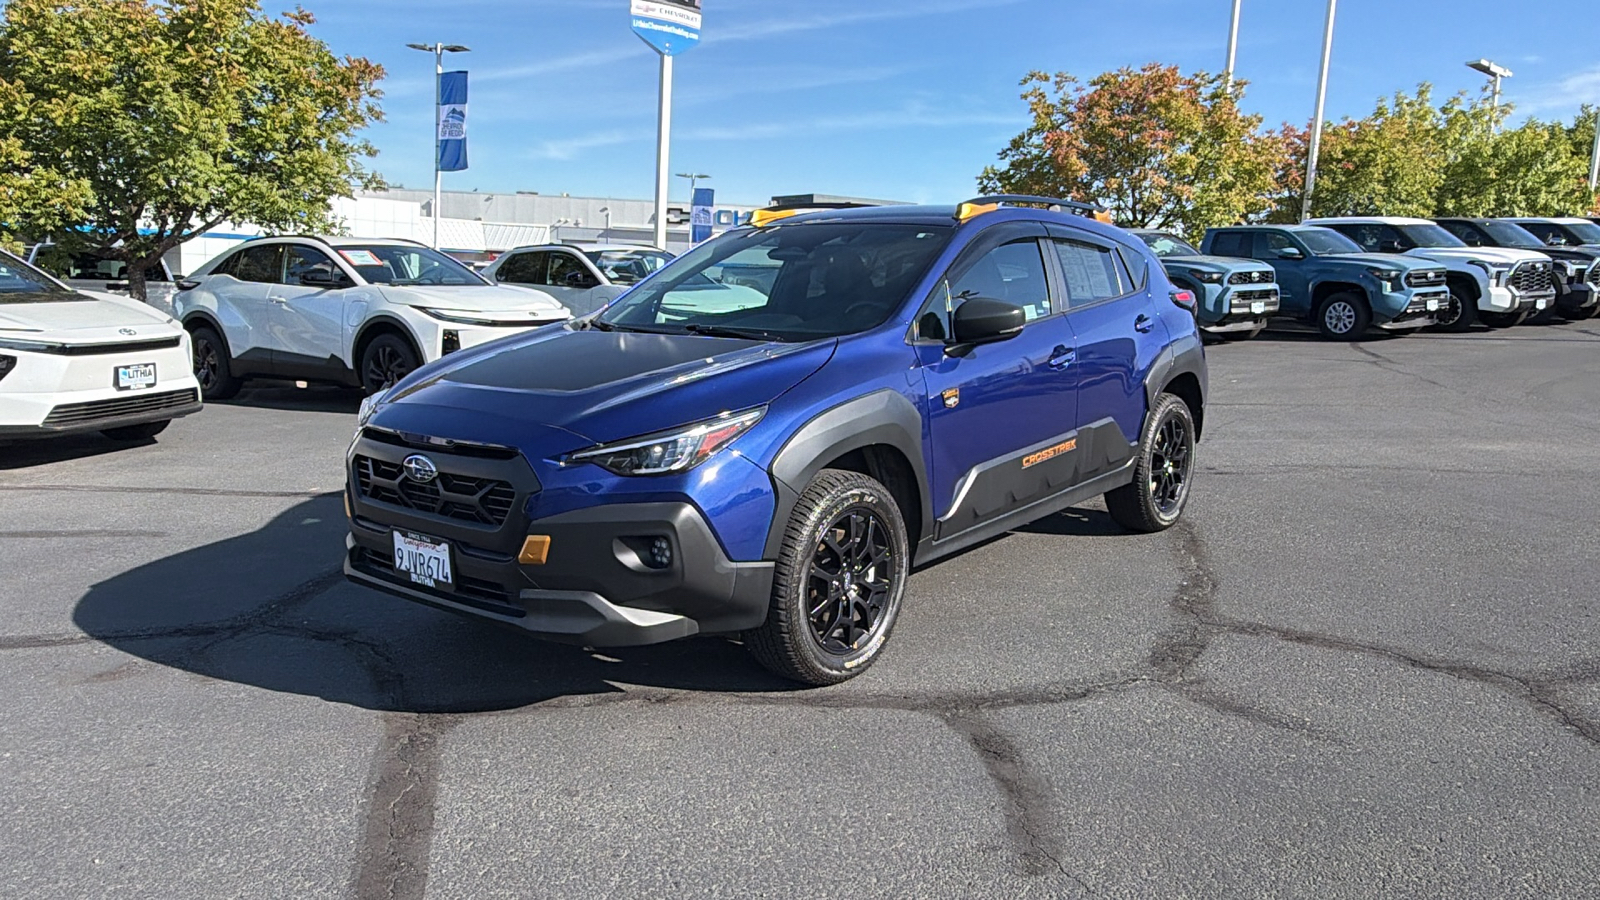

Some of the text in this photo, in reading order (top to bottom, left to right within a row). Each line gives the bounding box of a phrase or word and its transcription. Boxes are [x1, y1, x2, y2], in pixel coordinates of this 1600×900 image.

[659, 7, 698, 23] CHEVROLET
[127, 368, 153, 379] LITHIA
[1021, 438, 1077, 469] CROSSTREK
[396, 547, 450, 583] 9JVR674
